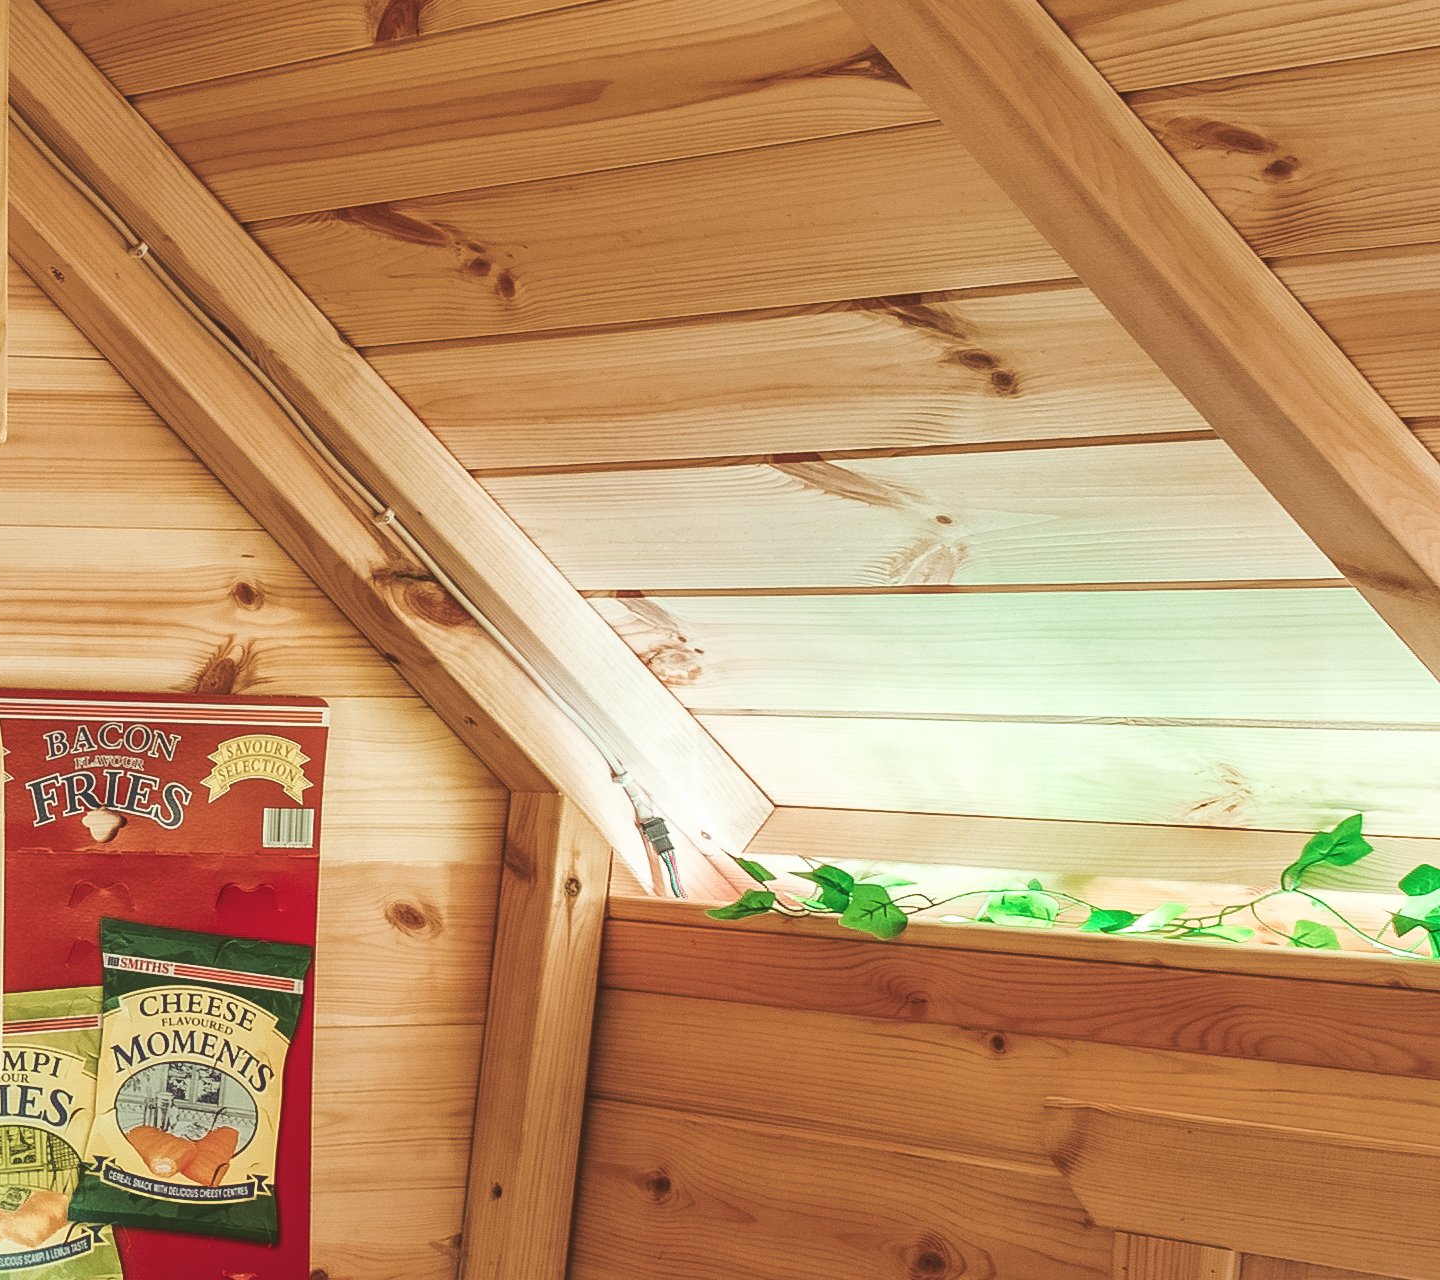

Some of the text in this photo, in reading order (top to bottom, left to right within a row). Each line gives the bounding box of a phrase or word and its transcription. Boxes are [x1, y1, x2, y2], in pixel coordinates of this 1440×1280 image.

[43, 721, 181, 761] BACON
[225, 740, 294, 761] SAVOURY
[75, 755, 145, 770] FLAVOUR
[217, 759, 298, 783] SELECTION
[26, 769, 192, 829] FRIES
[139, 992, 258, 1032] CHEESE
[161, 1017, 234, 1036] FLAVOURED
[111, 1030, 276, 1093] MOMENTS
[133, 1179, 152, 1191] SNACK
[24, 1252, 45, 1264] SCAMPI
